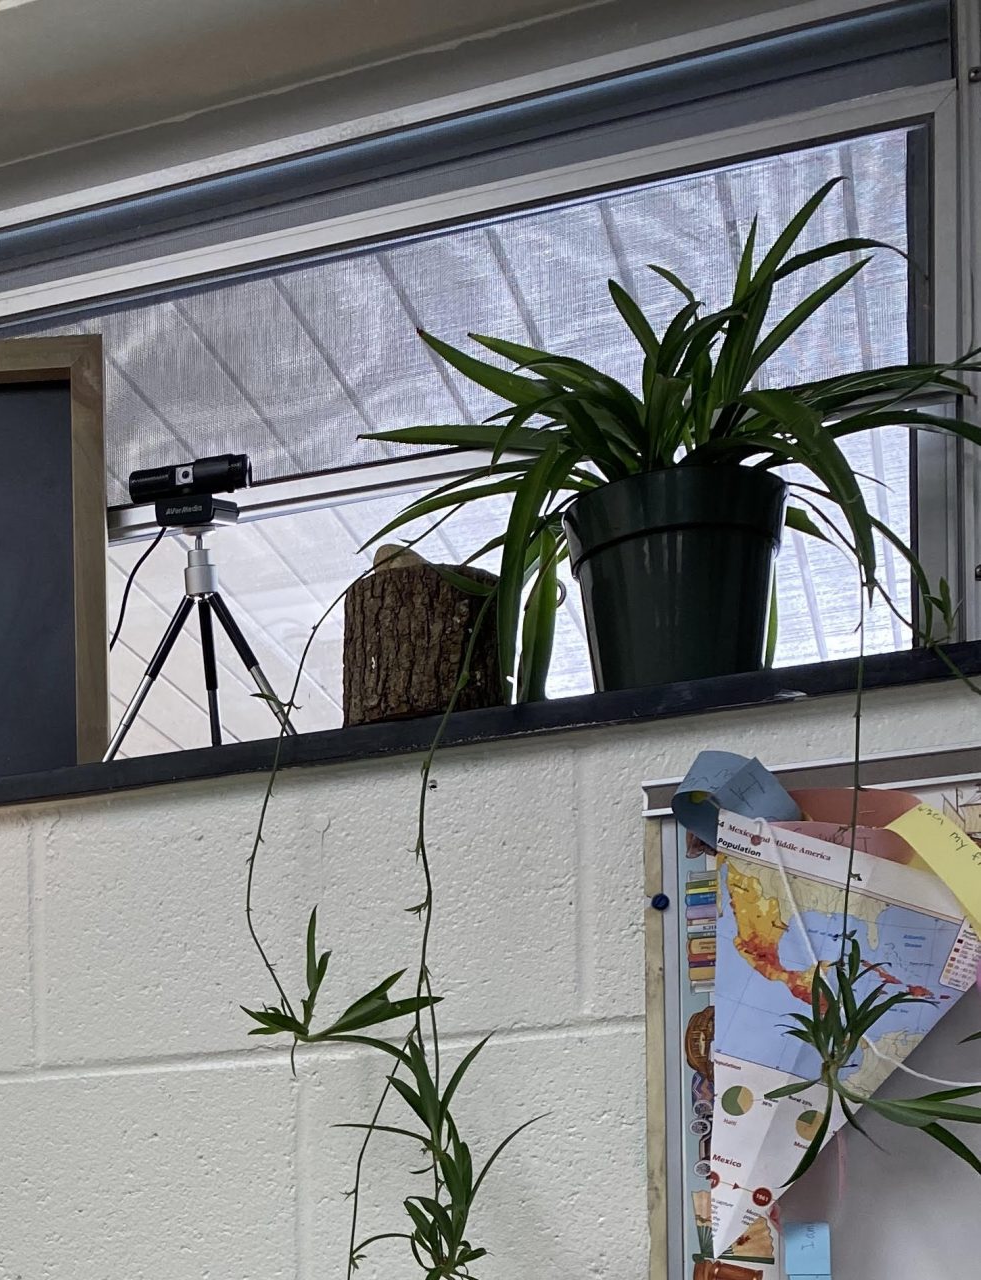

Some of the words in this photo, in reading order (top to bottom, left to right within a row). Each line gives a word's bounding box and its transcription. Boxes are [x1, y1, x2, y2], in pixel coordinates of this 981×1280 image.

[165, 505, 203, 515] AVerMedia
[717, 838, 761, 858] Population
[727, 824, 754, 839] Mexico
[799, 847, 831, 861] America
[712, 1154, 742, 1168] Mexico
